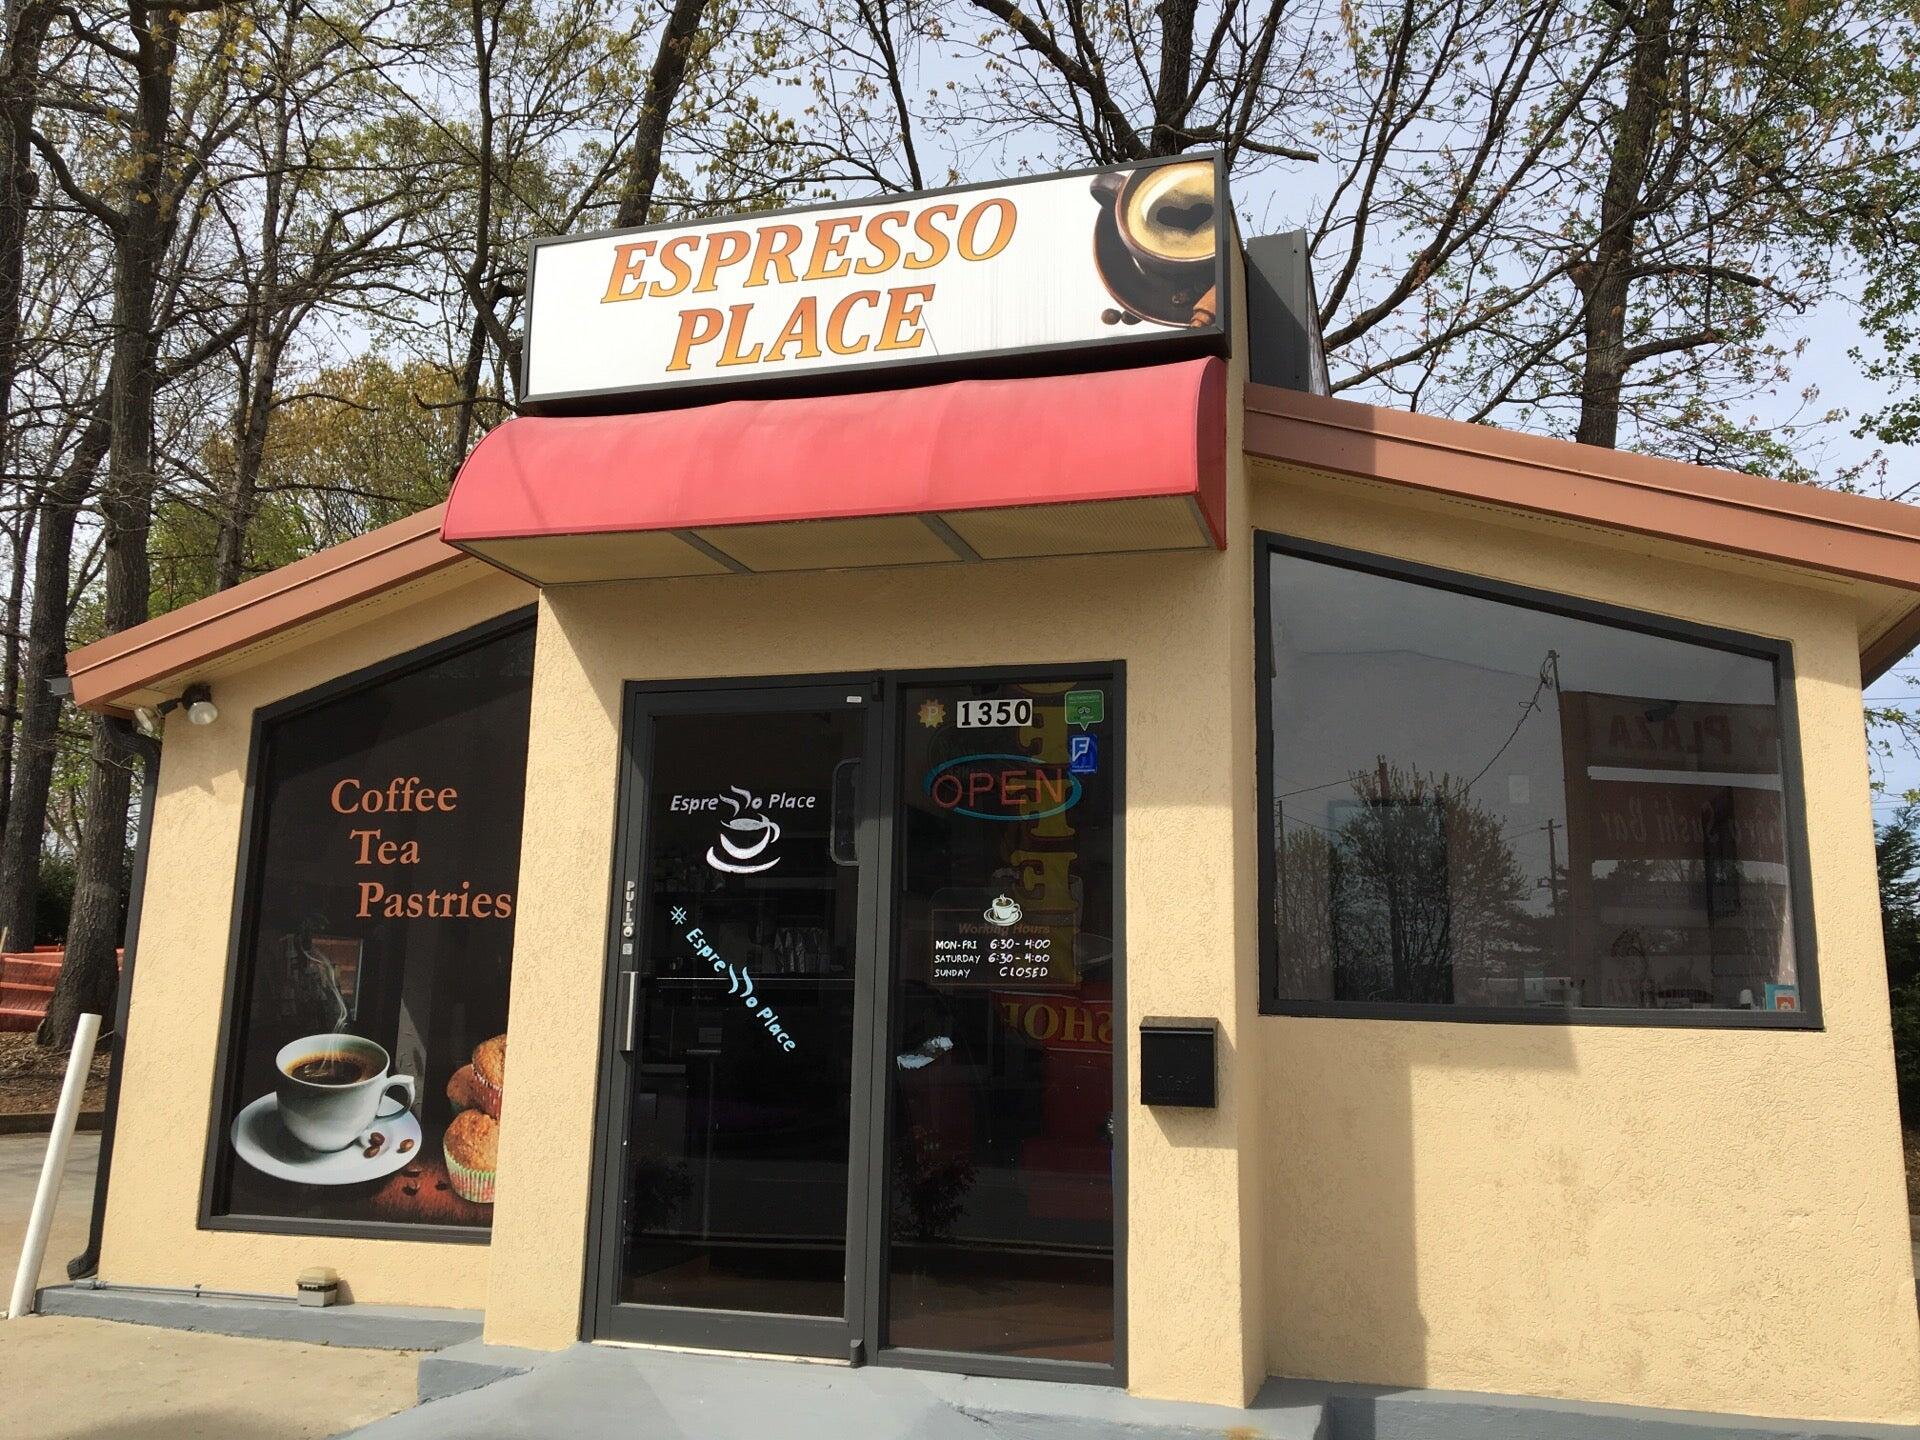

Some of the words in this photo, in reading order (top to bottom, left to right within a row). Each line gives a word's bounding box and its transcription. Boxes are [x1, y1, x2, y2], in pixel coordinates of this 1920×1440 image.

[600, 198, 1017, 304] ESPRESSO
[666, 284, 935, 371] PLACE
[961, 700, 1031, 726] 1350
[331, 777, 458, 813] Coffee
[768, 792, 816, 809] Place
[932, 768, 1065, 808] OPEN
[350, 829, 420, 865] Tea
[356, 881, 512, 918] Pastries
[625, 880, 635, 923] PULL
[935, 940, 977, 950] MON-FRI
[958, 922, 1009, 936] Working
[1013, 924, 1050, 935] Hours
[934, 954, 981, 964] SATURDAY
[934, 968, 971, 978] SUNDAY
[999, 966, 1048, 978] CLOSED
[756, 1006, 796, 1052] Place
